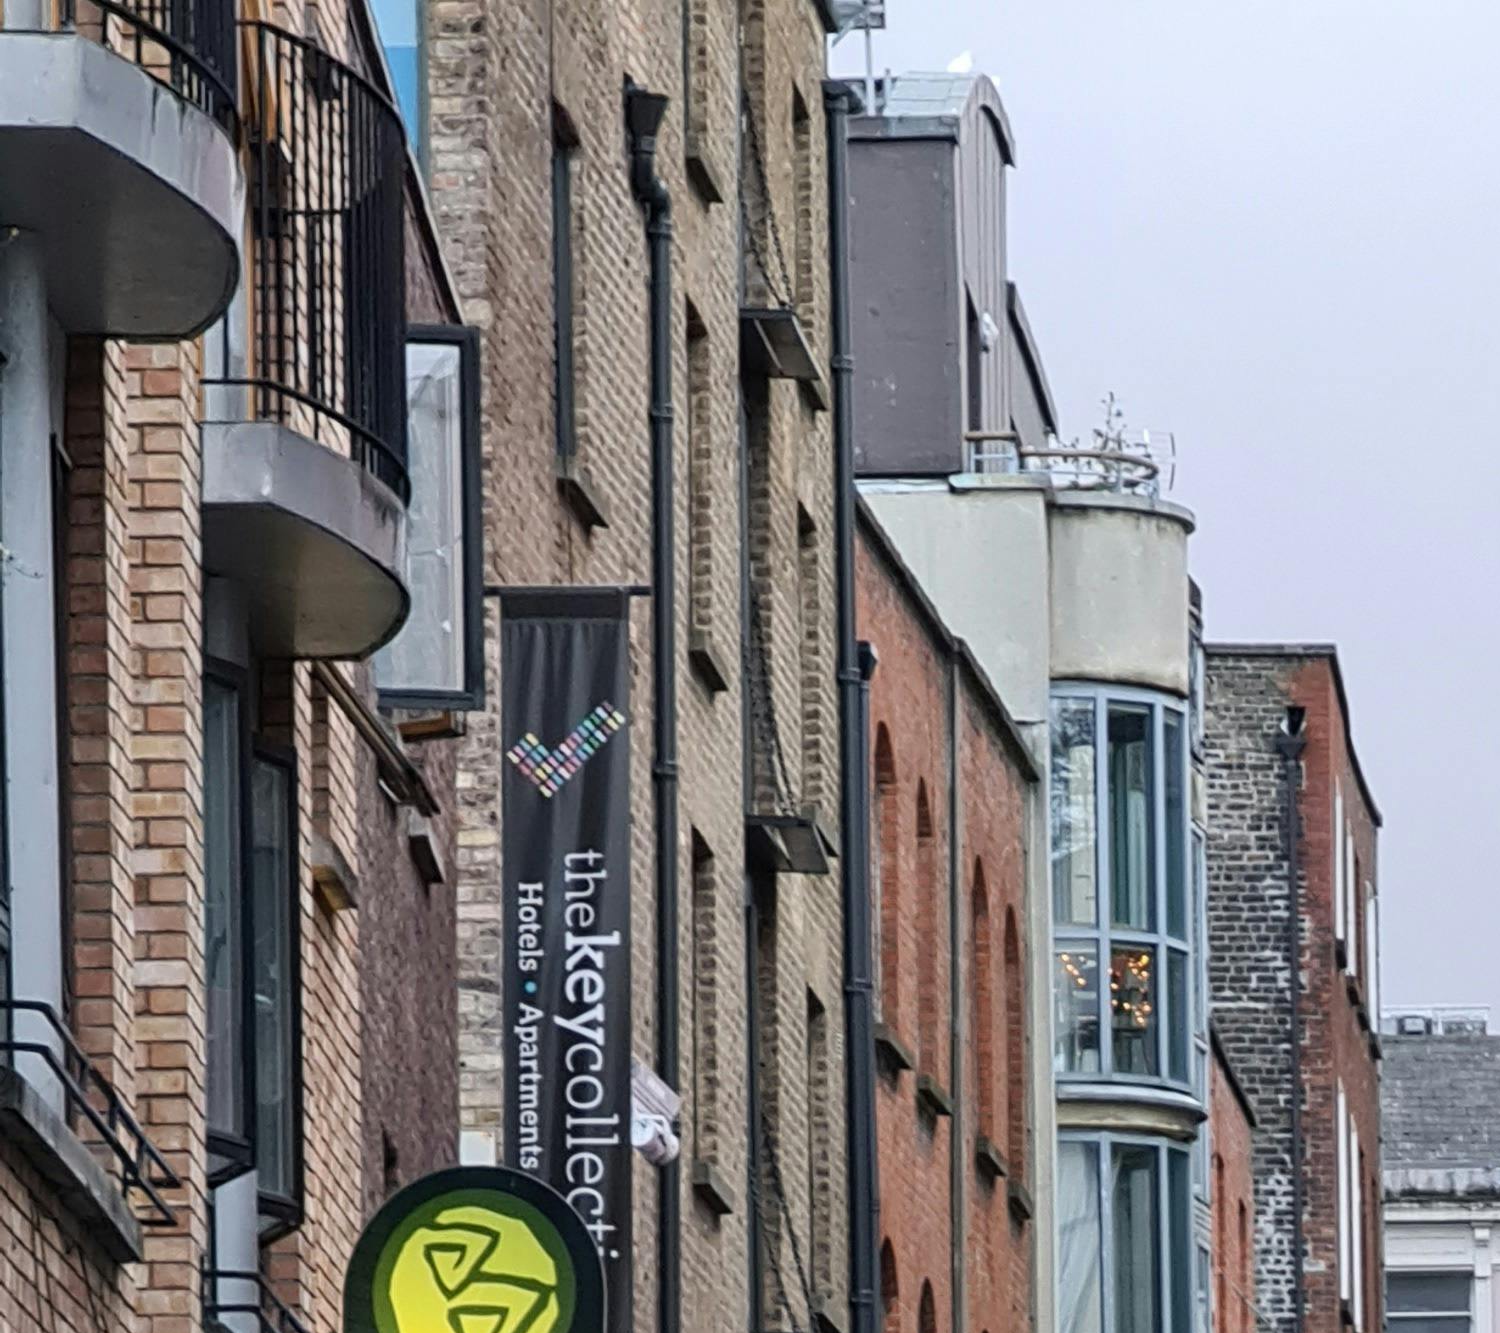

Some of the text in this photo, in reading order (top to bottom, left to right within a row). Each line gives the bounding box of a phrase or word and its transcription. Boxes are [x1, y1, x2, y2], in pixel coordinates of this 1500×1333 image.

[513, 881, 544, 1170] Hotels Apartments
[553, 849, 620, 1258] thekeycollect
